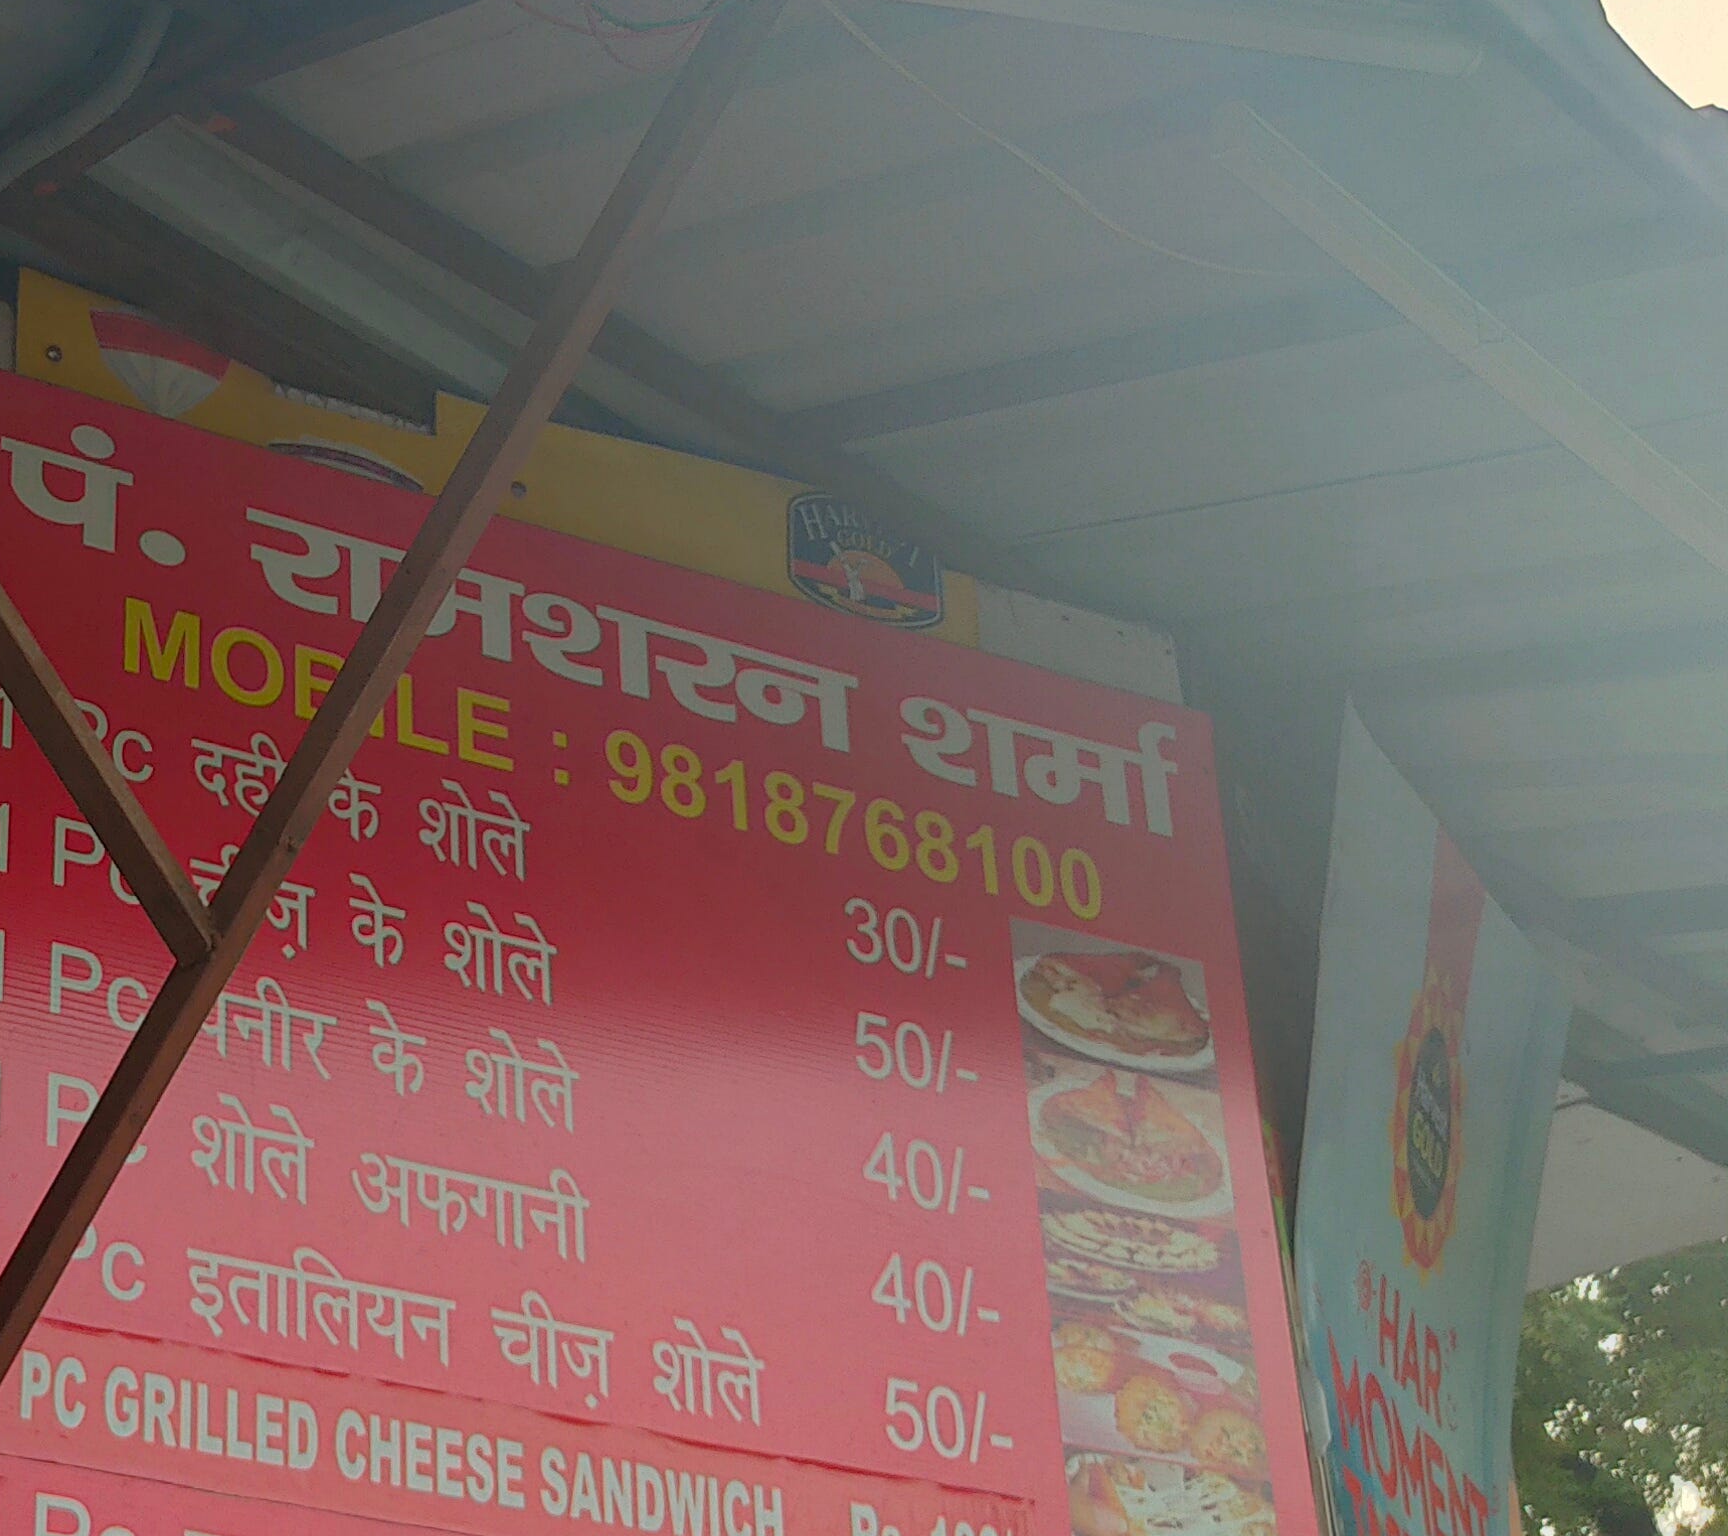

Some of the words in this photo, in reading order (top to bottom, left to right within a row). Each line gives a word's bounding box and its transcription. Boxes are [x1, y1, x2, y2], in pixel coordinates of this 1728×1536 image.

[1, 425, 185, 565] पं.
[902, 698, 1177, 837] शर्मा
[327, 767, 381, 842] क
[419, 779, 531, 880] शोले
[553, 732, 570, 786] :
[607, 731, 1103, 921] 9818768100
[349, 873, 405, 967] के
[444, 902, 557, 1006] शोले
[844, 898, 967, 978] 30/-
[49, 943, 147, 1033] Pc
[367, 1000, 425, 1096] के
[464, 1028, 580, 1132] शोले
[855, 1013, 980, 1094] 50/-
[46, 1072, 146, 1163] P
[193, 1094, 313, 1205] शोले
[352, 1152, 589, 1261] अफगानी
[863, 1133, 990, 1214] 40/-
[186, 1247, 455, 1366] इतालियन
[491, 1290, 614, 1408] चीज़
[652, 1318, 764, 1425] शोले
[872, 1254, 1000, 1336] 40/-
[1377, 1272, 1443, 1429] HAR
[20, 1351, 84, 1428] PC
[104, 1367, 317, 1469] GRILLED
[335, 1410, 525, 1509] CHEESE
[886, 1377, 1013, 1462] 50/-
